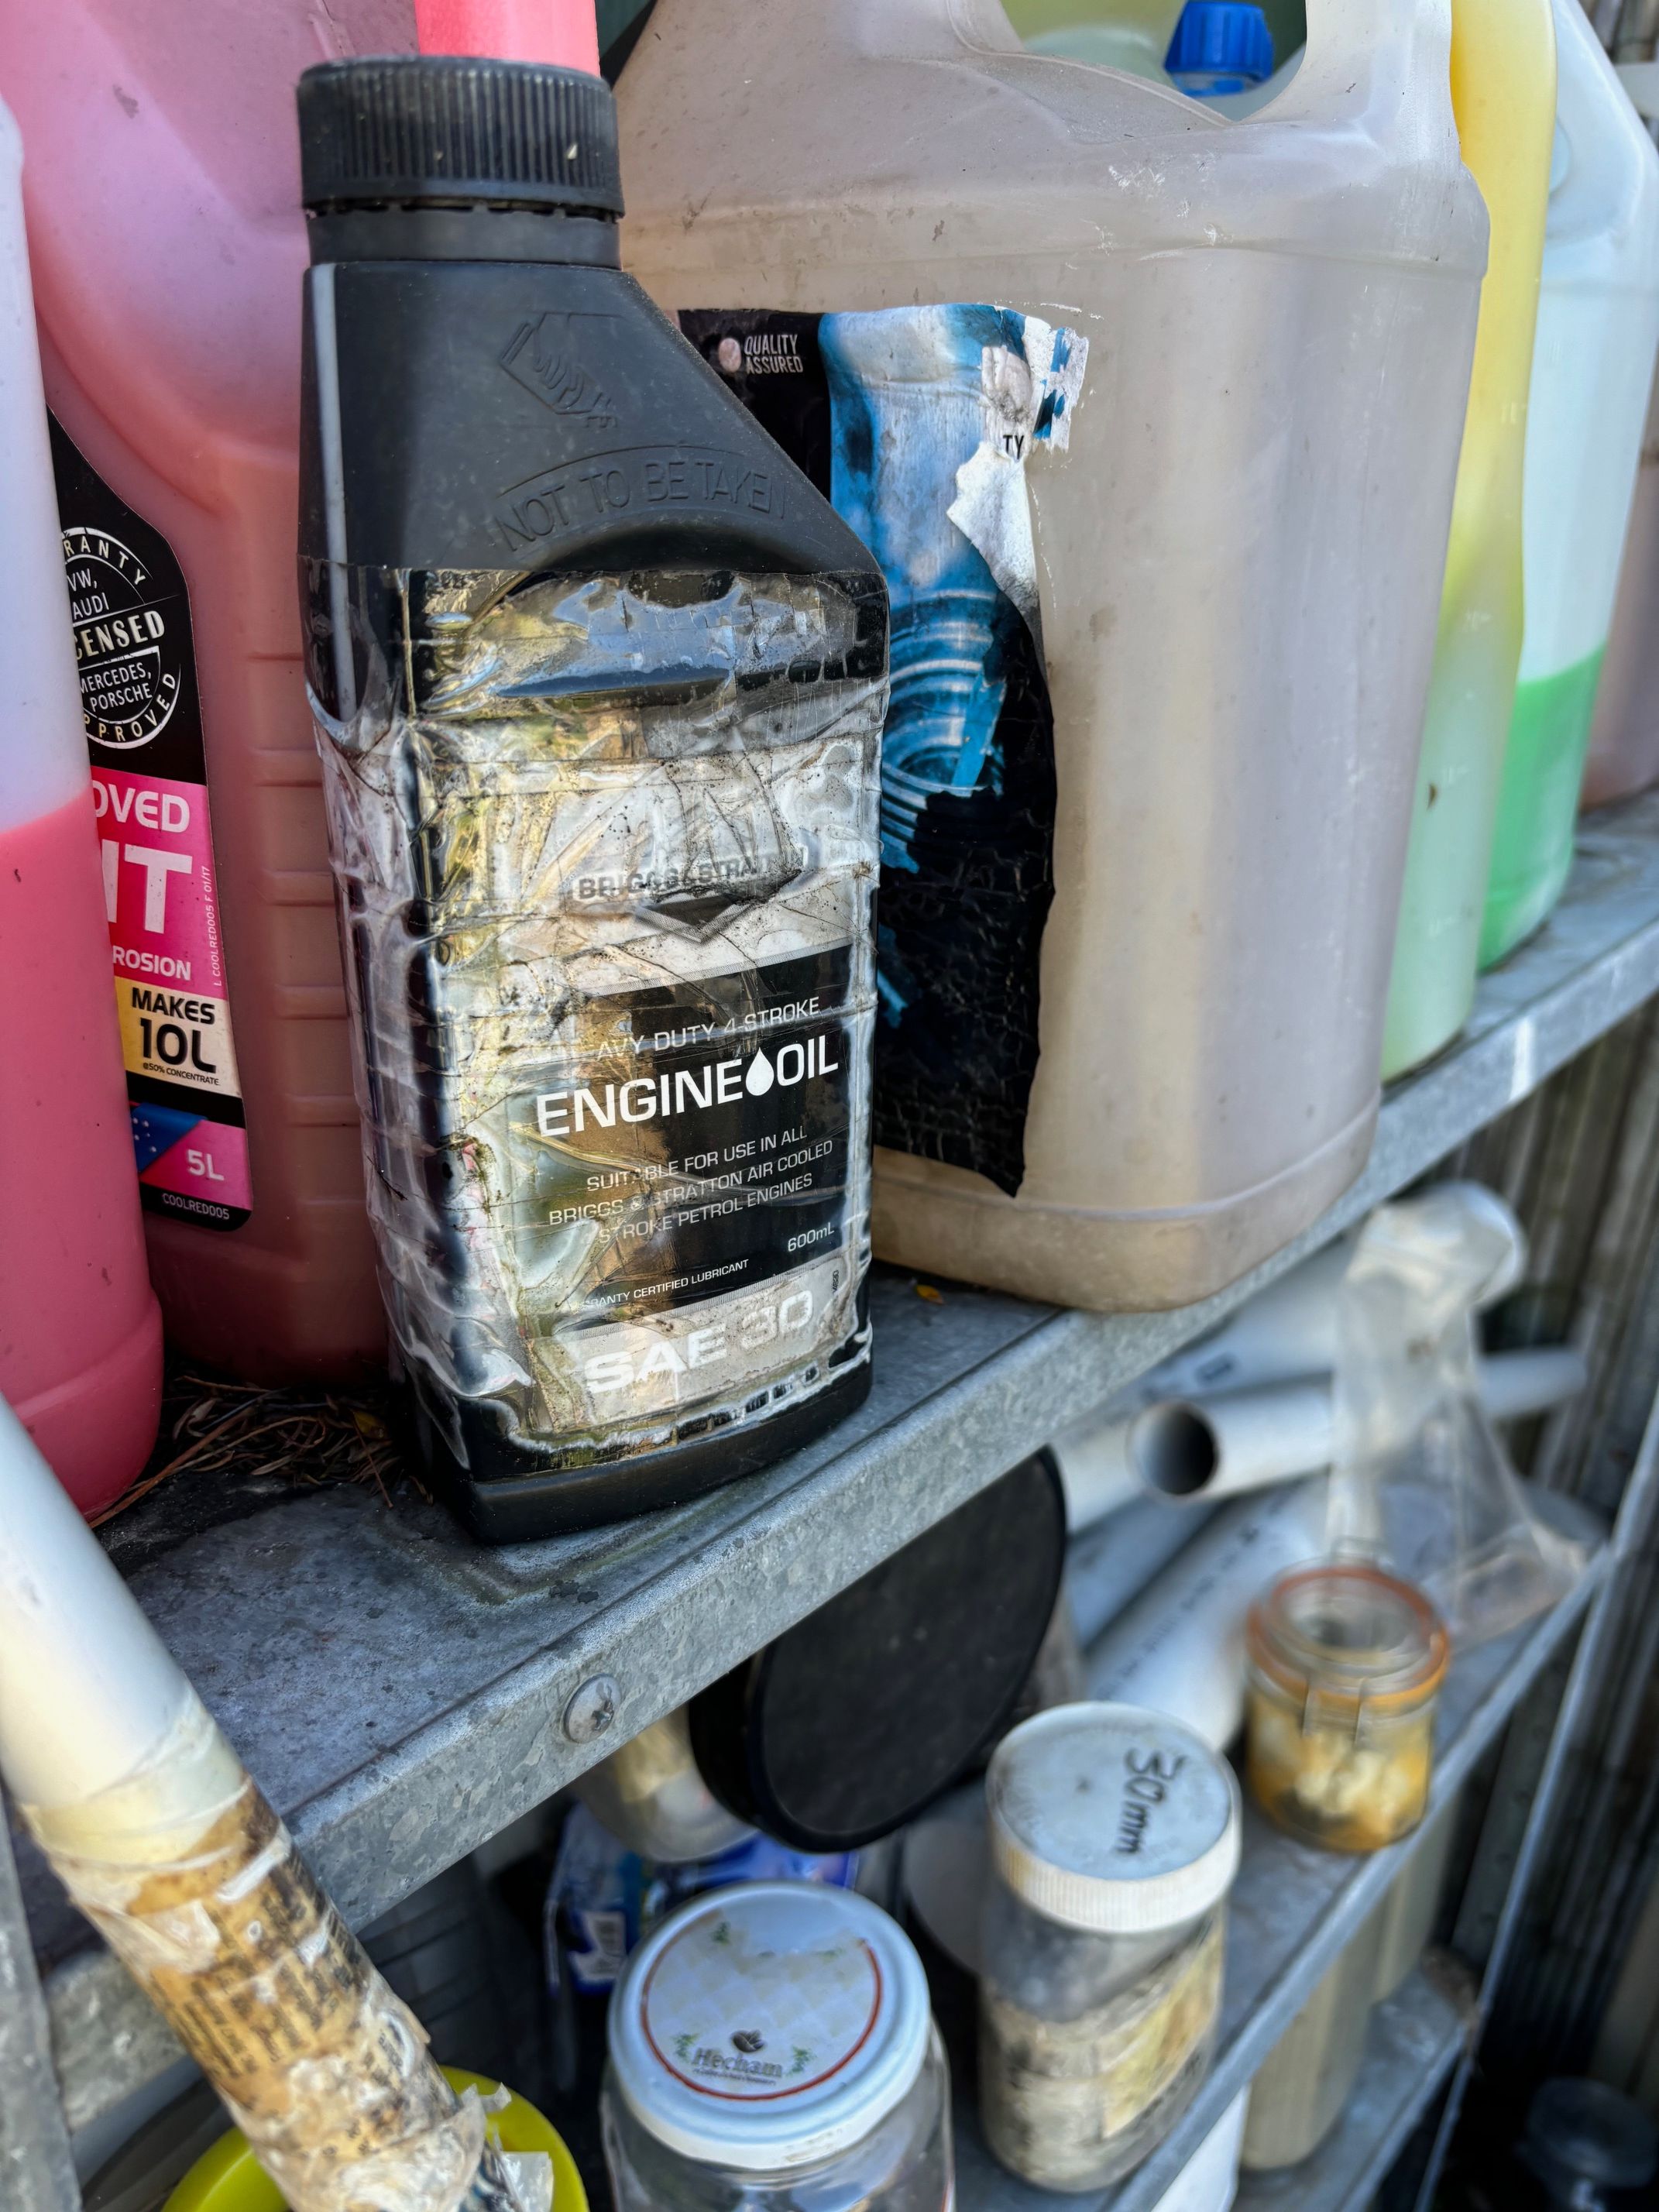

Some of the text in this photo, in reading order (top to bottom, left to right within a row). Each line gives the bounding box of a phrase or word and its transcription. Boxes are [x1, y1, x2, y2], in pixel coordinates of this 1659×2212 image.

[744, 334, 798, 356] QUALITY
[746, 356, 804, 375] ASSURED
[494, 485, 569, 551] NOT
[579, 470, 630, 513] TO
[645, 462, 689, 503] BE
[73, 592, 109, 620] AUDI
[90, 682, 153, 712] PORSCHE
[201, 866, 212, 893] 01/17
[112, 945, 191, 981] ROSION
[132, 987, 215, 1025] MAKES
[654, 1022, 716, 1052] DUTY
[723, 996, 820, 1033] 4-STROKE
[140, 1017, 217, 1074] 10L
[166, 1066, 221, 1086] CONCENTRATE
[536, 1035, 839, 1137] ENGINE OIL
[187, 1149, 224, 1181] 5L
[684, 1151, 719, 1173] FOR
[724, 1140, 756, 1163] USE
[761, 1134, 777, 1152] IN
[781, 1125, 807, 1146] ALL
[549, 1199, 623, 1226] BRIGGS
[651, 1170, 743, 1206] STRATTON
[747, 1161, 773, 1183] AIR
[778, 1140, 833, 1172] COOLED
[678, 1197, 744, 1227] PETROL
[747, 1173, 812, 1208] ENGINES
[788, 1222, 835, 1252] 600mL
[634, 1278, 689, 1299] CERTIFIED
[691, 1259, 750, 1285] LUBRICANT
[584, 1289, 813, 1394] SAE 30
